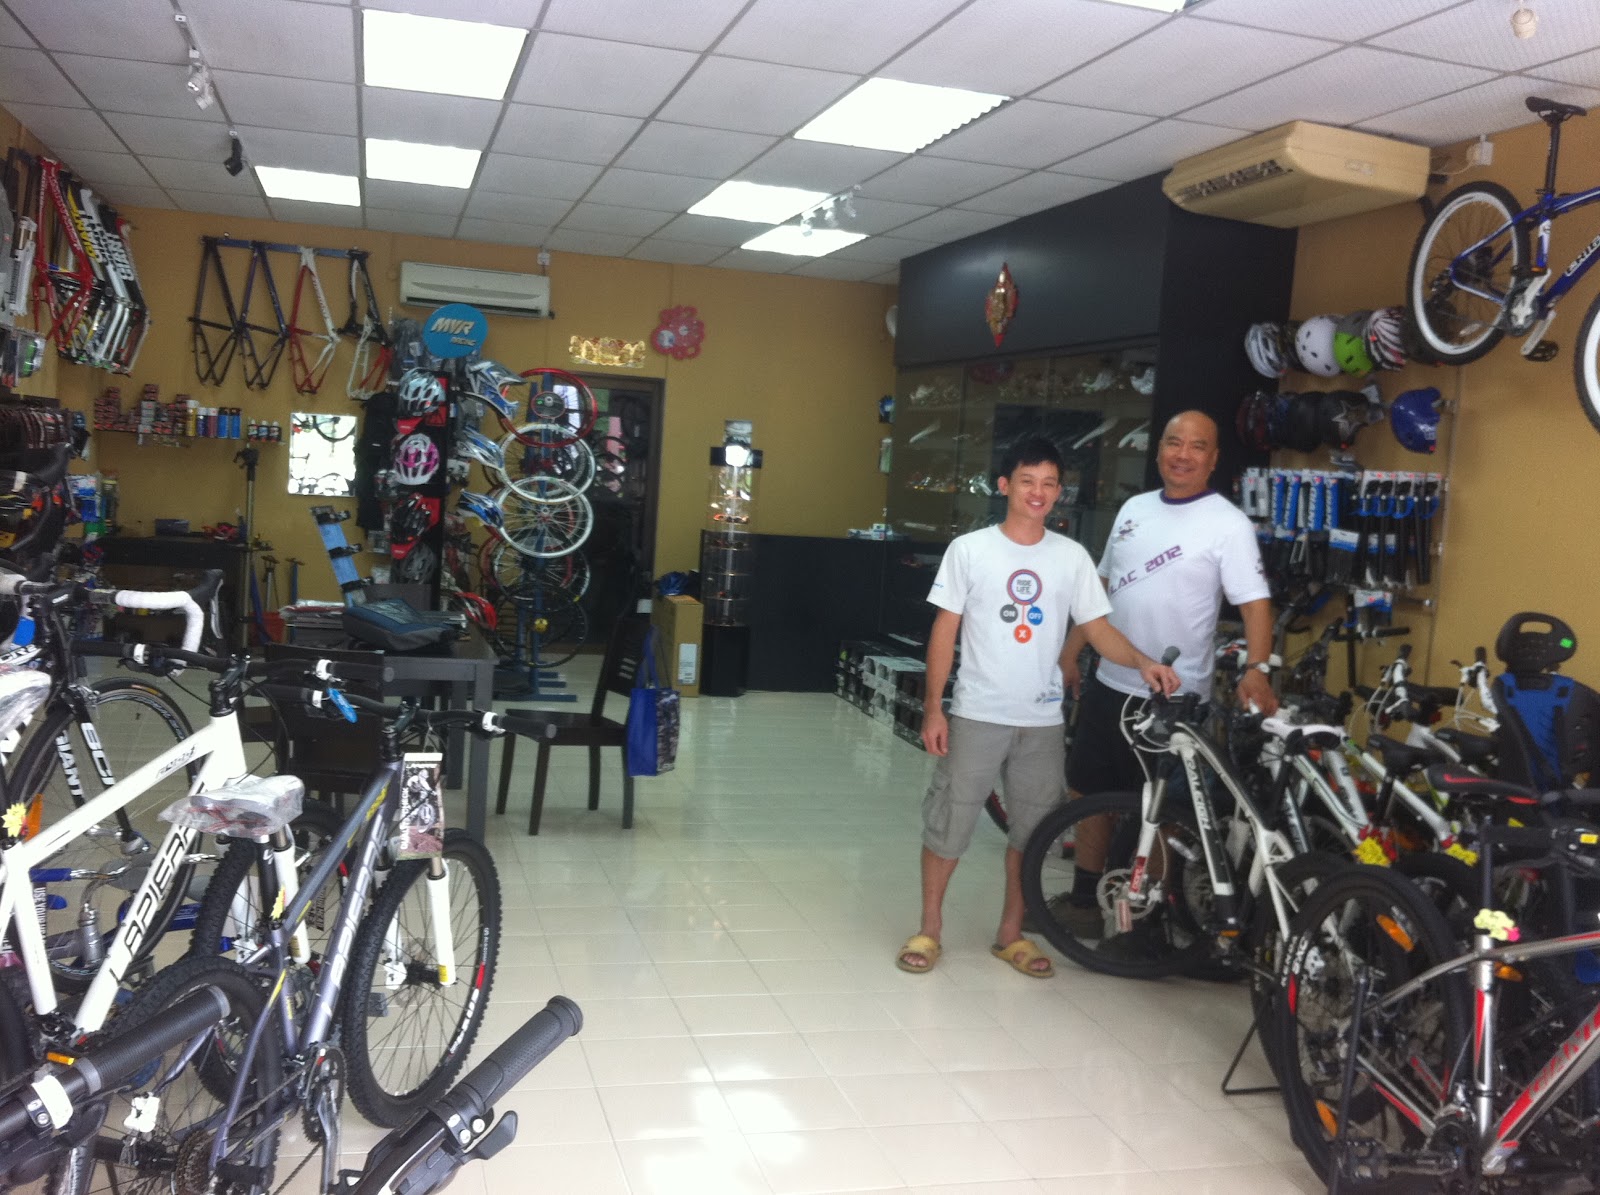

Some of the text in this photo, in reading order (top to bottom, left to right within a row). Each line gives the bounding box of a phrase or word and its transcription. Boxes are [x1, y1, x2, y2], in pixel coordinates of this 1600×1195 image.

[105, 232, 135, 281] GIANT
[1144, 545, 1183, 573] 2012
[1016, 579, 1032, 587] RIDE
[1002, 610, 1016, 618] ON
[1028, 612, 1043, 620] OFF
